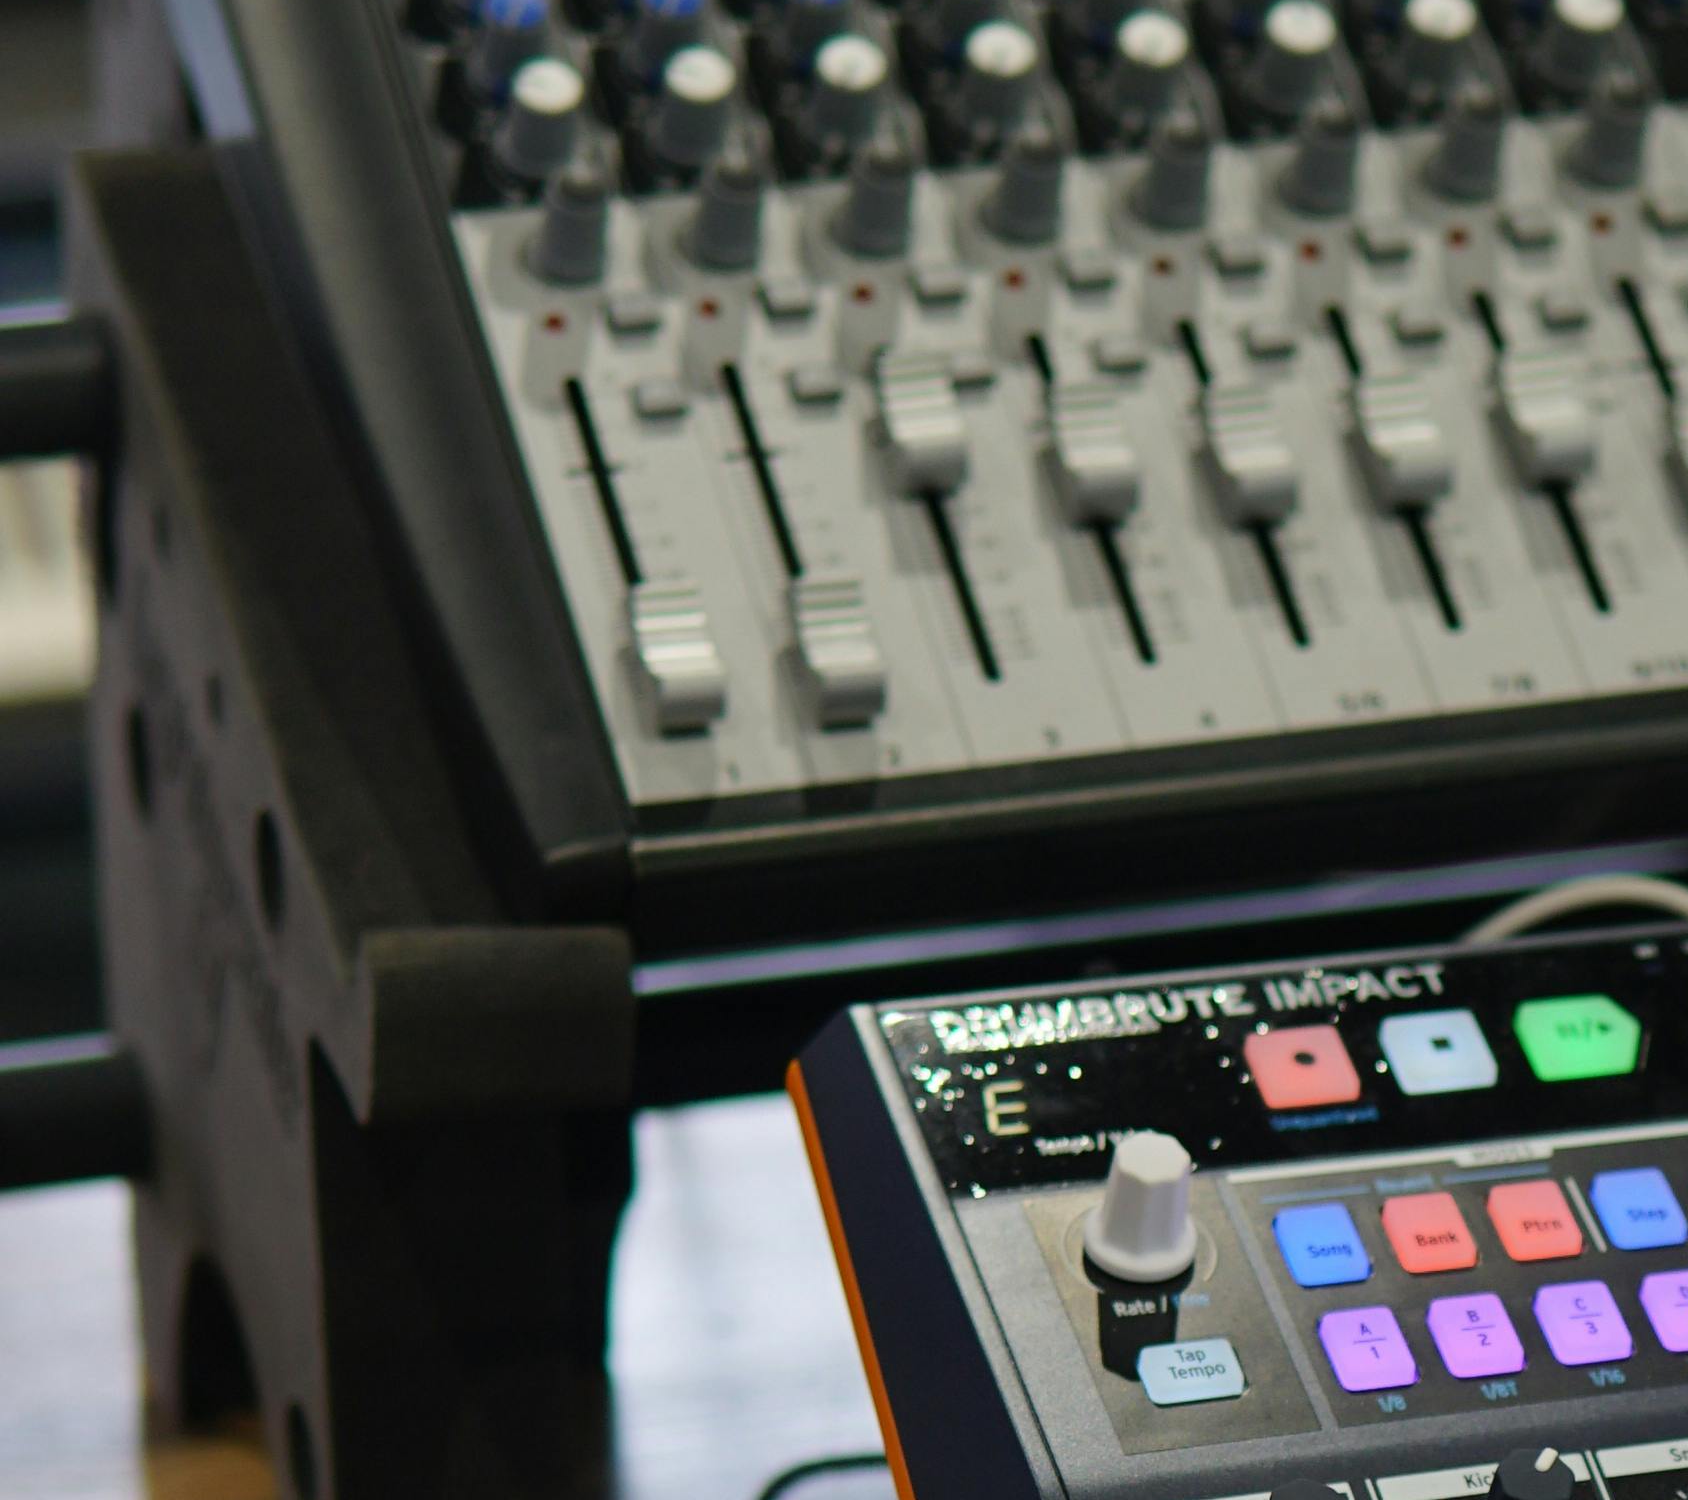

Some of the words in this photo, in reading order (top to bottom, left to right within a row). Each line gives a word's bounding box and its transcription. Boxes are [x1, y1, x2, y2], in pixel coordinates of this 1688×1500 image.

[1263, 964, 1445, 1011] IMPACT
[1415, 1231, 1460, 1247] Bank
[1112, 1301, 1157, 1317] Rate
[1574, 1297, 1588, 1311] C
[1467, 1309, 1480, 1323] B
[1359, 1322, 1372, 1336] A
[1587, 1320, 1599, 1335] 3
[1478, 1333, 1491, 1347] 2
[1174, 1349, 1206, 1365] Tap
[1371, 1346, 1380, 1359] 1
[1167, 1362, 1226, 1381] Tempo
[1465, 1471, 1494, 1489] Kic
